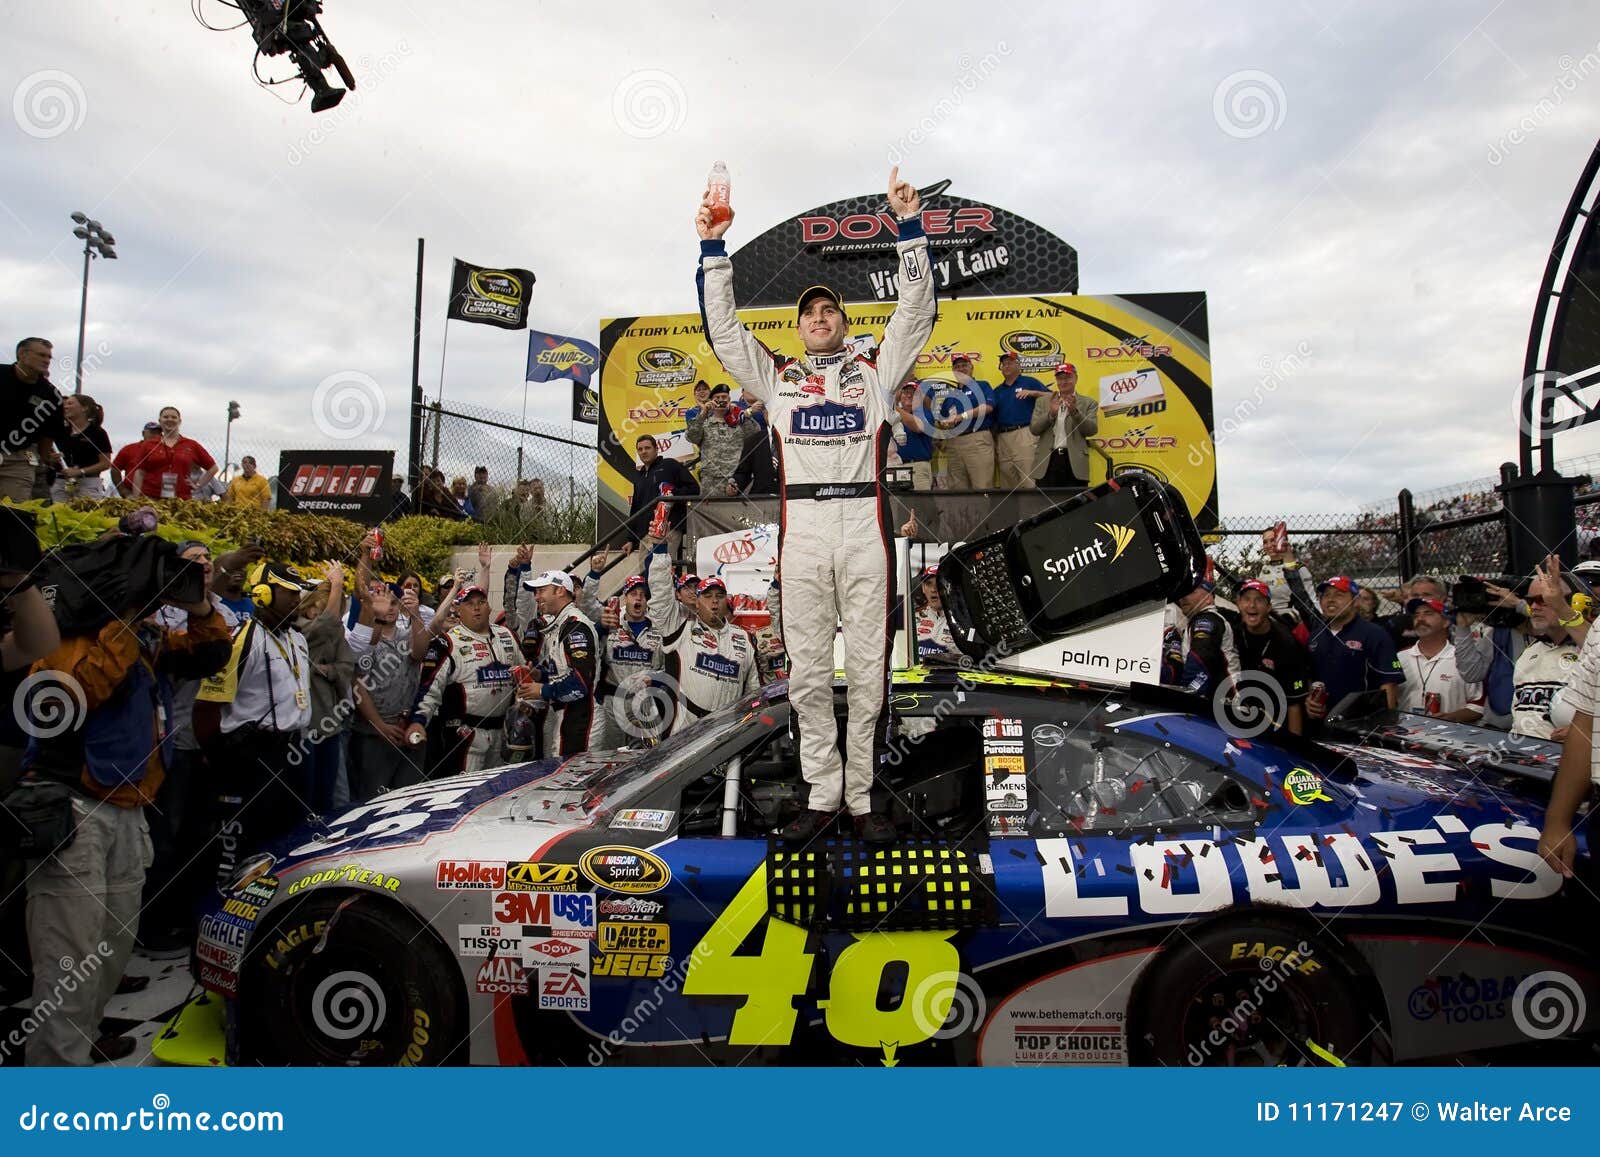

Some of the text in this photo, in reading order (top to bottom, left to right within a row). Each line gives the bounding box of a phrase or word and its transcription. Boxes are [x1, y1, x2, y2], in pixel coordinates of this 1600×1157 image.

[956, 244, 1010, 278] Lane
[965, 308, 1063, 321] VICTORY LANE
[1020, 342, 1039, 350] Sprint
[1086, 345, 1173, 359] DOVER
[539, 350, 593, 365] SUNOCO
[1111, 377, 1138, 395] AAA
[628, 407, 687, 420] DOVE
[1126, 399, 1167, 418] 400
[800, 411, 857, 430] LOWE'S
[795, 437, 811, 446] Build
[811, 437, 846, 447] Something
[847, 433, 873, 445] Together
[291, 469, 381, 496] SPEED
[815, 486, 856, 497] Johnson
[297, 500, 361, 511] SPEEDtv.com
[716, 540, 754, 564] AAA
[1043, 537, 1108, 582] Sprint
[618, 649, 649, 661] LOWE'S
[1061, 650, 1110, 668] palm
[702, 655, 736, 675] LOWE'S
[983, 745, 1024, 755] Purolator
[986, 783, 1026, 791] SIEMENS
[1297, 782, 1321, 793] STATE
[605, 855, 637, 865] NASCAR
[1036, 815, 1565, 918] LOWE'S
[438, 862, 505, 889] Holley
[610, 866, 640, 879] Sprint
[287, 864, 401, 896] GOODYEAR
[507, 882, 578, 892] MECHANIX WEAR
[494, 892, 551, 925] 3M
[553, 894, 593, 927] USG
[631, 902, 664, 914] LIGHT
[201, 916, 245, 948] MAHLE
[552, 930, 594, 939] SHEETROCK
[619, 925, 658, 938] Auto
[460, 937, 522, 951] TISSOT
[617, 937, 666, 949] Meter
[682, 849, 969, 1048] 48
[532, 959, 547, 967] Dow
[592, 954, 668, 978] JEGS
[1230, 942, 1325, 976] EAGLE
[200, 966, 238, 993] Edelbrock
[542, 972, 587, 997] EA
[477, 983, 529, 994] TOOLS
[541, 996, 589, 1009] SPORTS
[1010, 1009, 1123, 1022] www.bethematch.org
[1441, 1002, 1506, 1024] TOOLS
[1015, 1035, 1121, 1050] TOP CHOICE
[1015, 1052, 1122, 1060] LUMBER PRODUCTS
